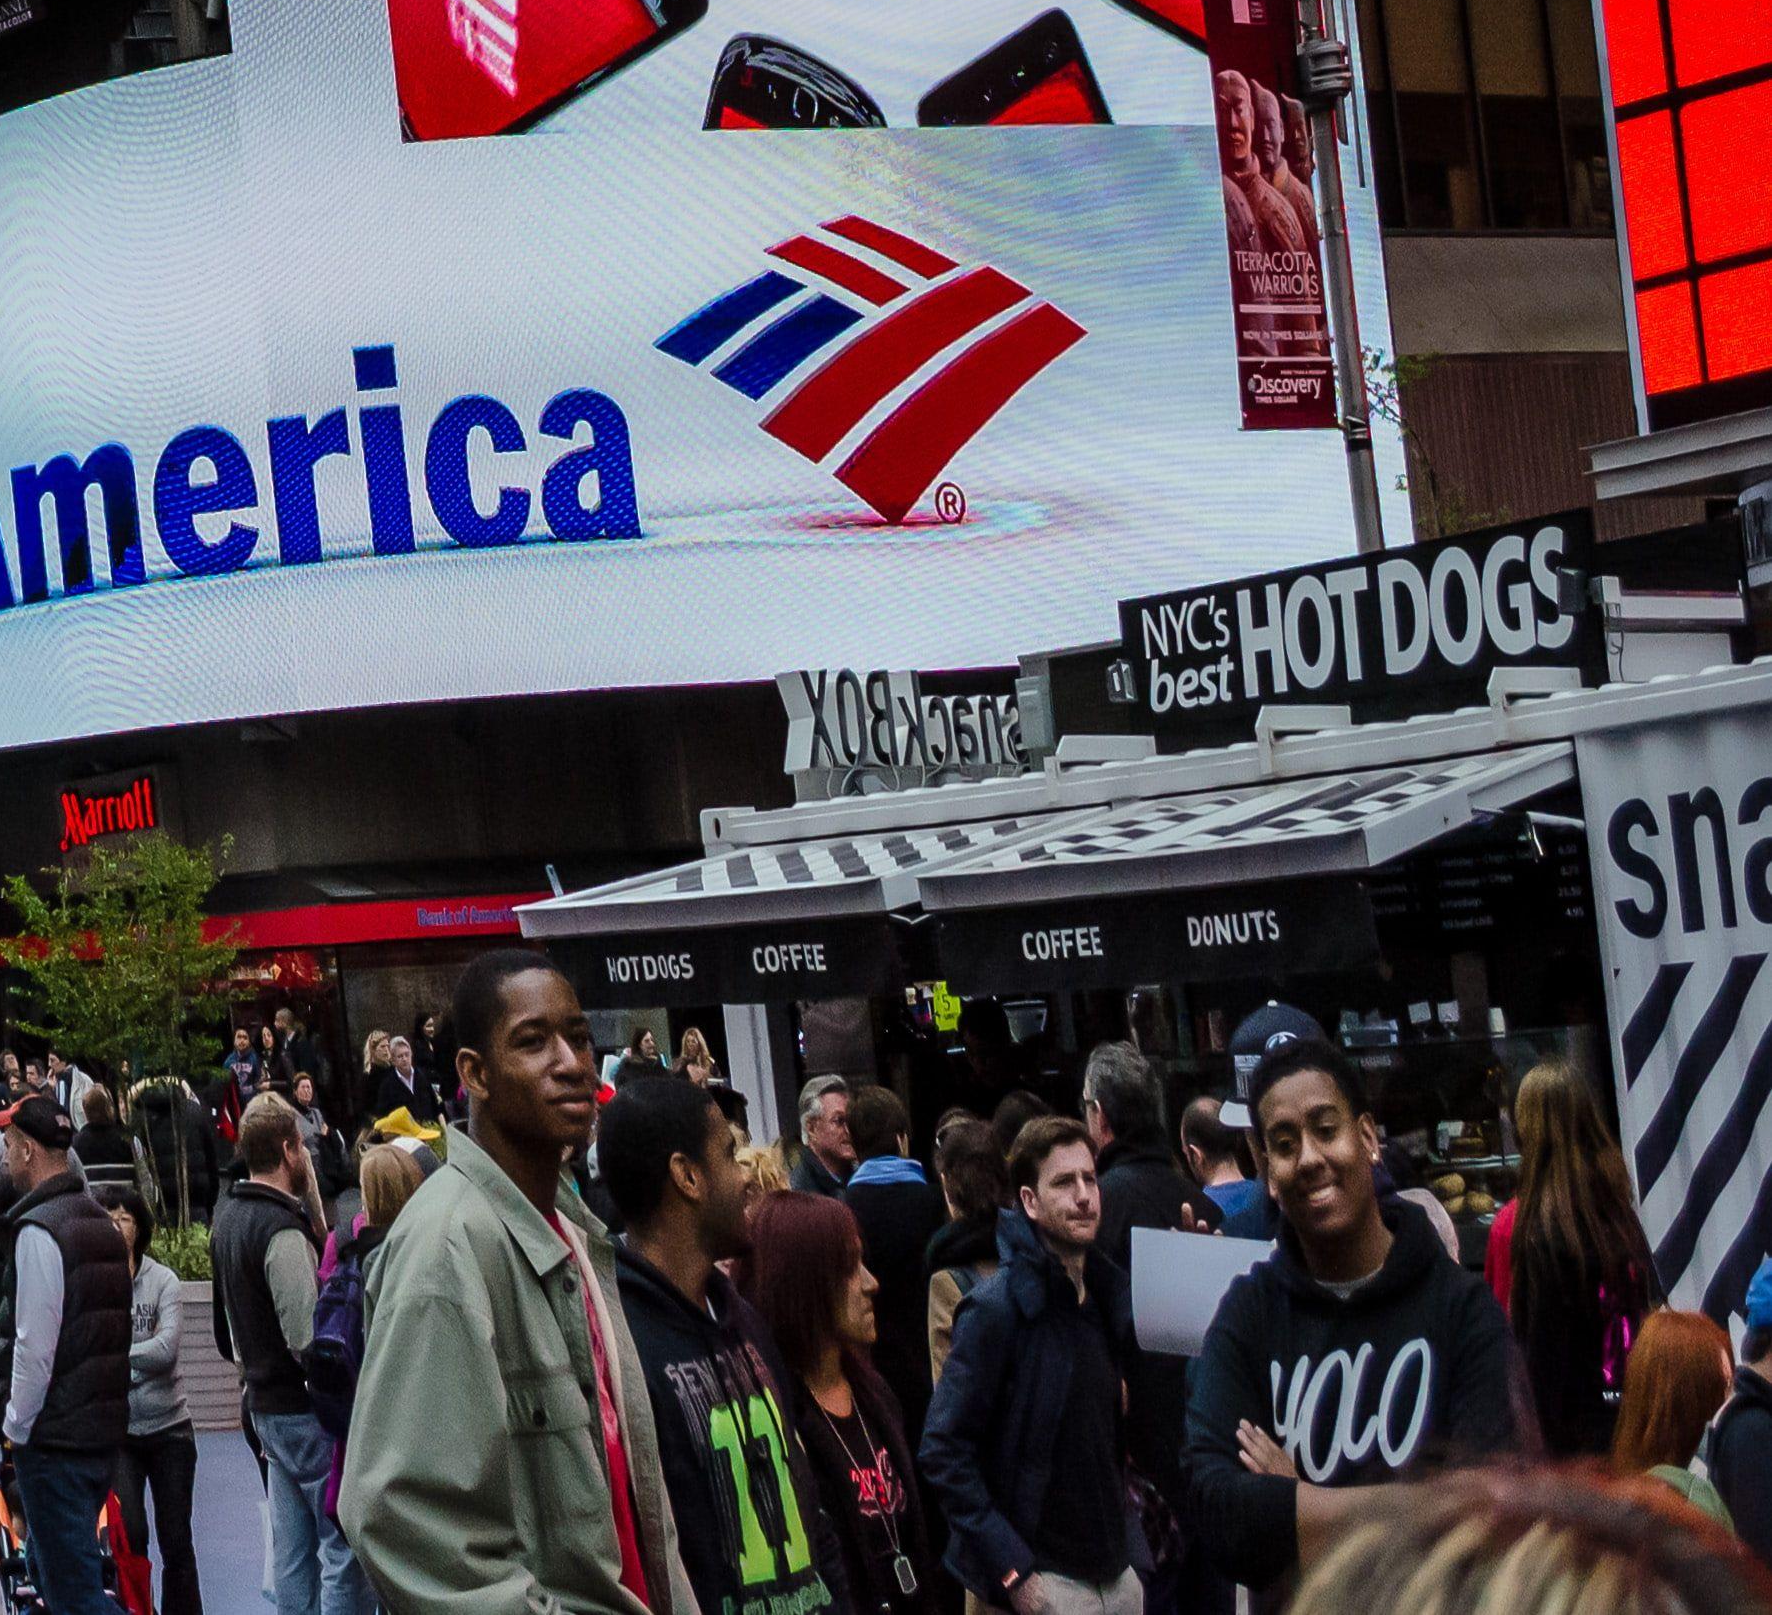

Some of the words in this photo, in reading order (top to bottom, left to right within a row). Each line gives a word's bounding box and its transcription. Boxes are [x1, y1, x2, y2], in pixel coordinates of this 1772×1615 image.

[1235, 250, 1316, 273] TERRACOTTA
[1250, 273, 1319, 295] WARRIORS
[1255, 374, 1322, 399] Discovery
[1140, 596, 1230, 660] NYC's
[1238, 560, 1369, 698] HOT
[1379, 525, 1575, 674] DOGS
[1148, 653, 1234, 714] best
[60, 777, 155, 851] Marriott
[607, 958, 644, 980] HOT
[645, 953, 694, 979] DOGS
[753, 944, 827, 972] COFFEE
[1022, 927, 1103, 961] COFFEE
[1187, 910, 1279, 947] DONUTS
[1270, 1337, 1430, 1483] YOLO
